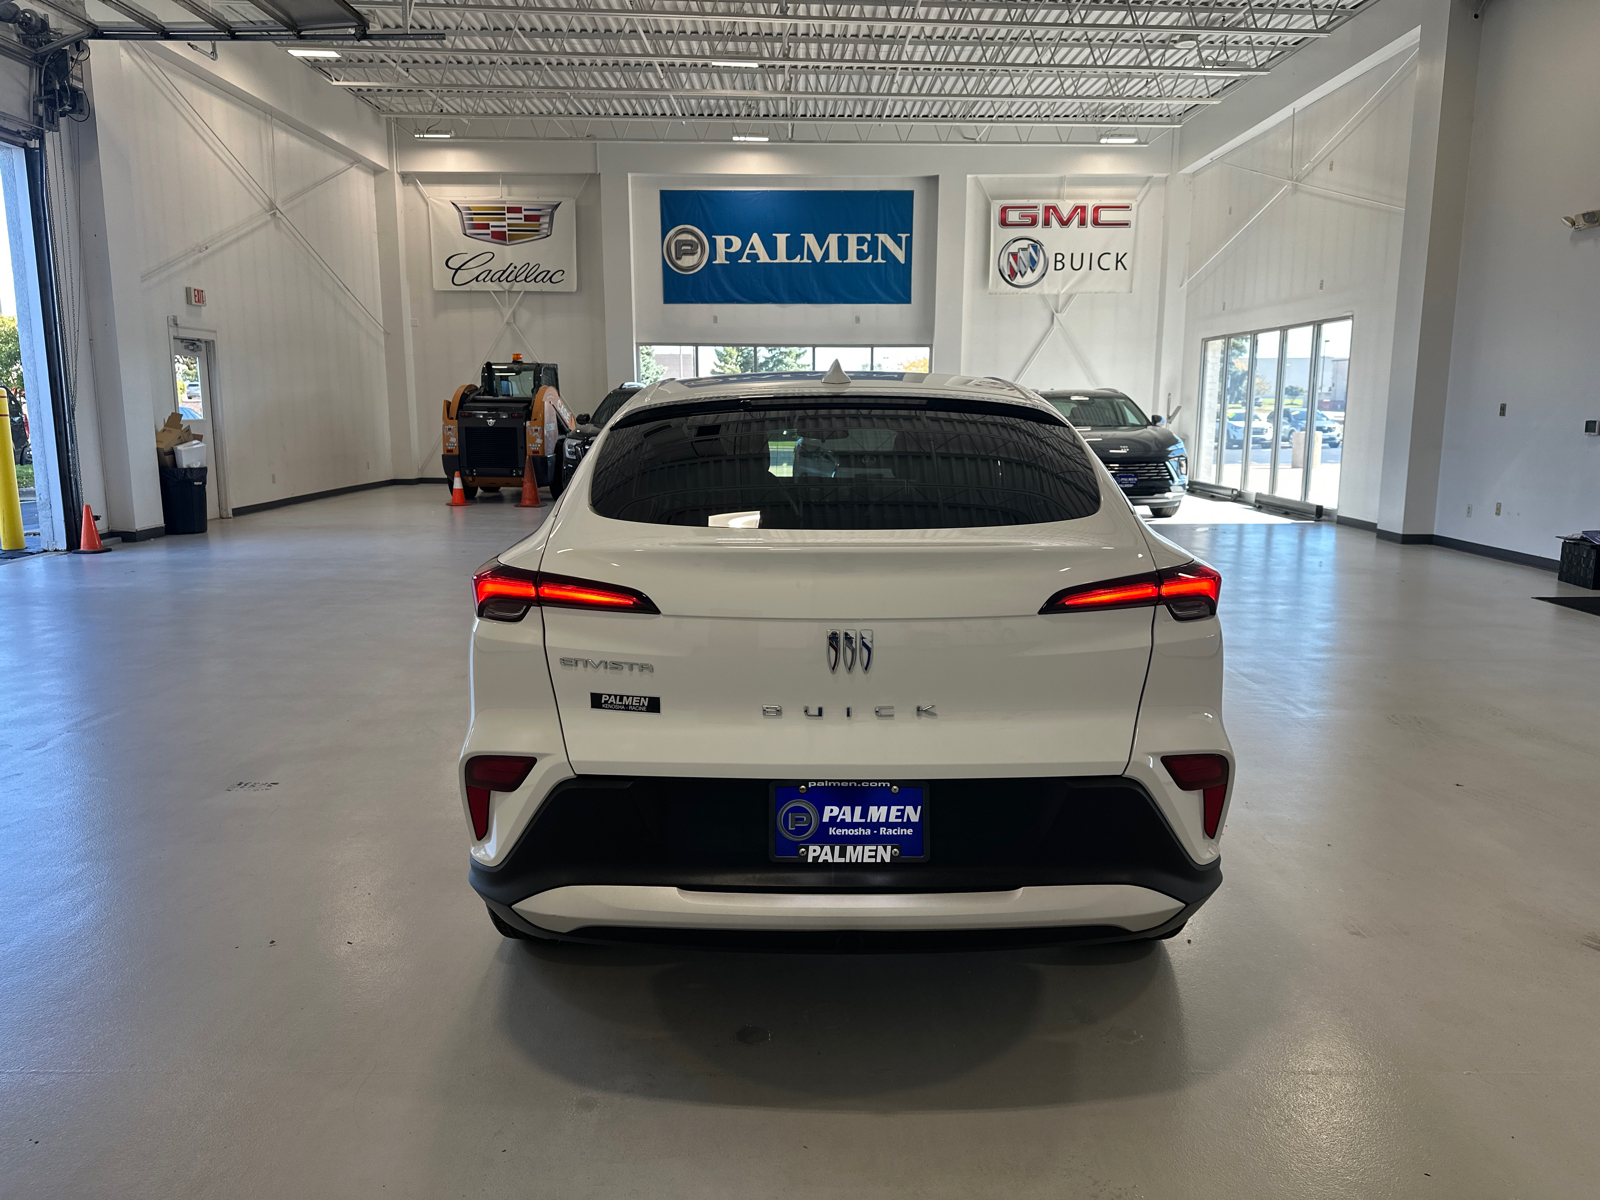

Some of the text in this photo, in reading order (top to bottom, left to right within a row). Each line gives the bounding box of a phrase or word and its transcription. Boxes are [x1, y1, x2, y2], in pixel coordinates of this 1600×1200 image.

[998, 203, 1132, 228] GMC
[711, 232, 911, 264] PALMEN
[444, 251, 565, 286] Cadillac
[1053, 252, 1128, 271] BUICK
[194, 288, 204, 303] EXIT
[559, 657, 654, 673] ENVISTA
[601, 694, 649, 706] PALMEN
[762, 704, 938, 717] BUICK
[822, 805, 922, 823] PALMEN
[828, 827, 871, 836] Kenosha
[879, 827, 913, 836] Racine
[807, 845, 892, 863] PALMEN
